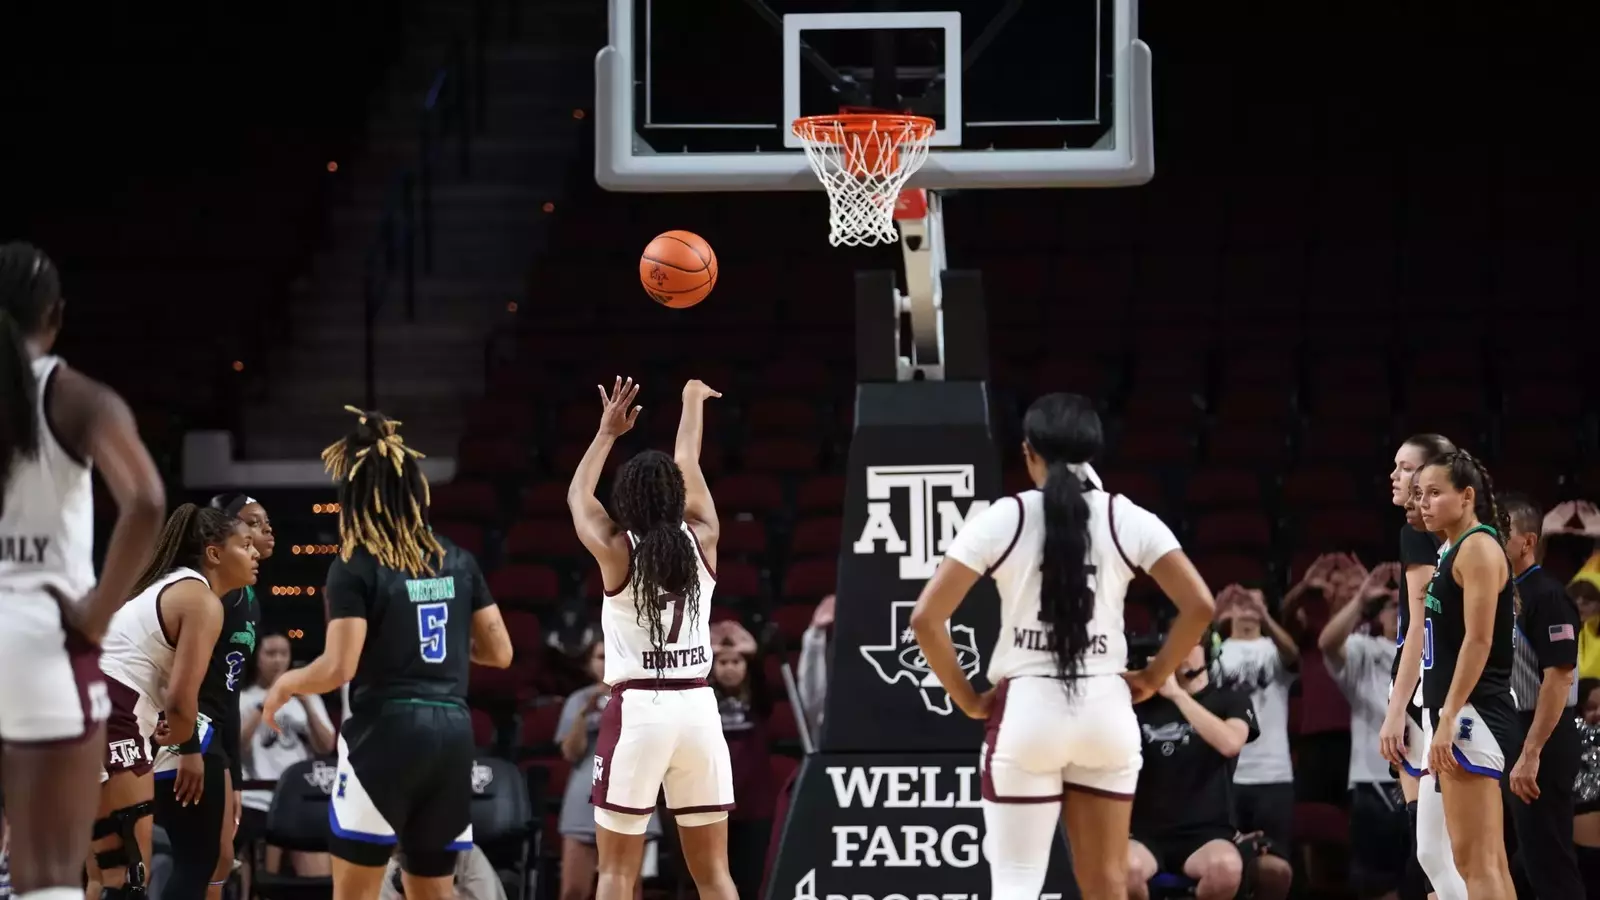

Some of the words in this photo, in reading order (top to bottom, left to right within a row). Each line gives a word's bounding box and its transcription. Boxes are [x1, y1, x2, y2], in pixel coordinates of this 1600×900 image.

[405, 576, 456, 602] WATSON
[417, 602, 448, 663] 5
[642, 645, 708, 670] HUNTER
[825, 766, 984, 808] WELL
[831, 824, 990, 868] FARG
